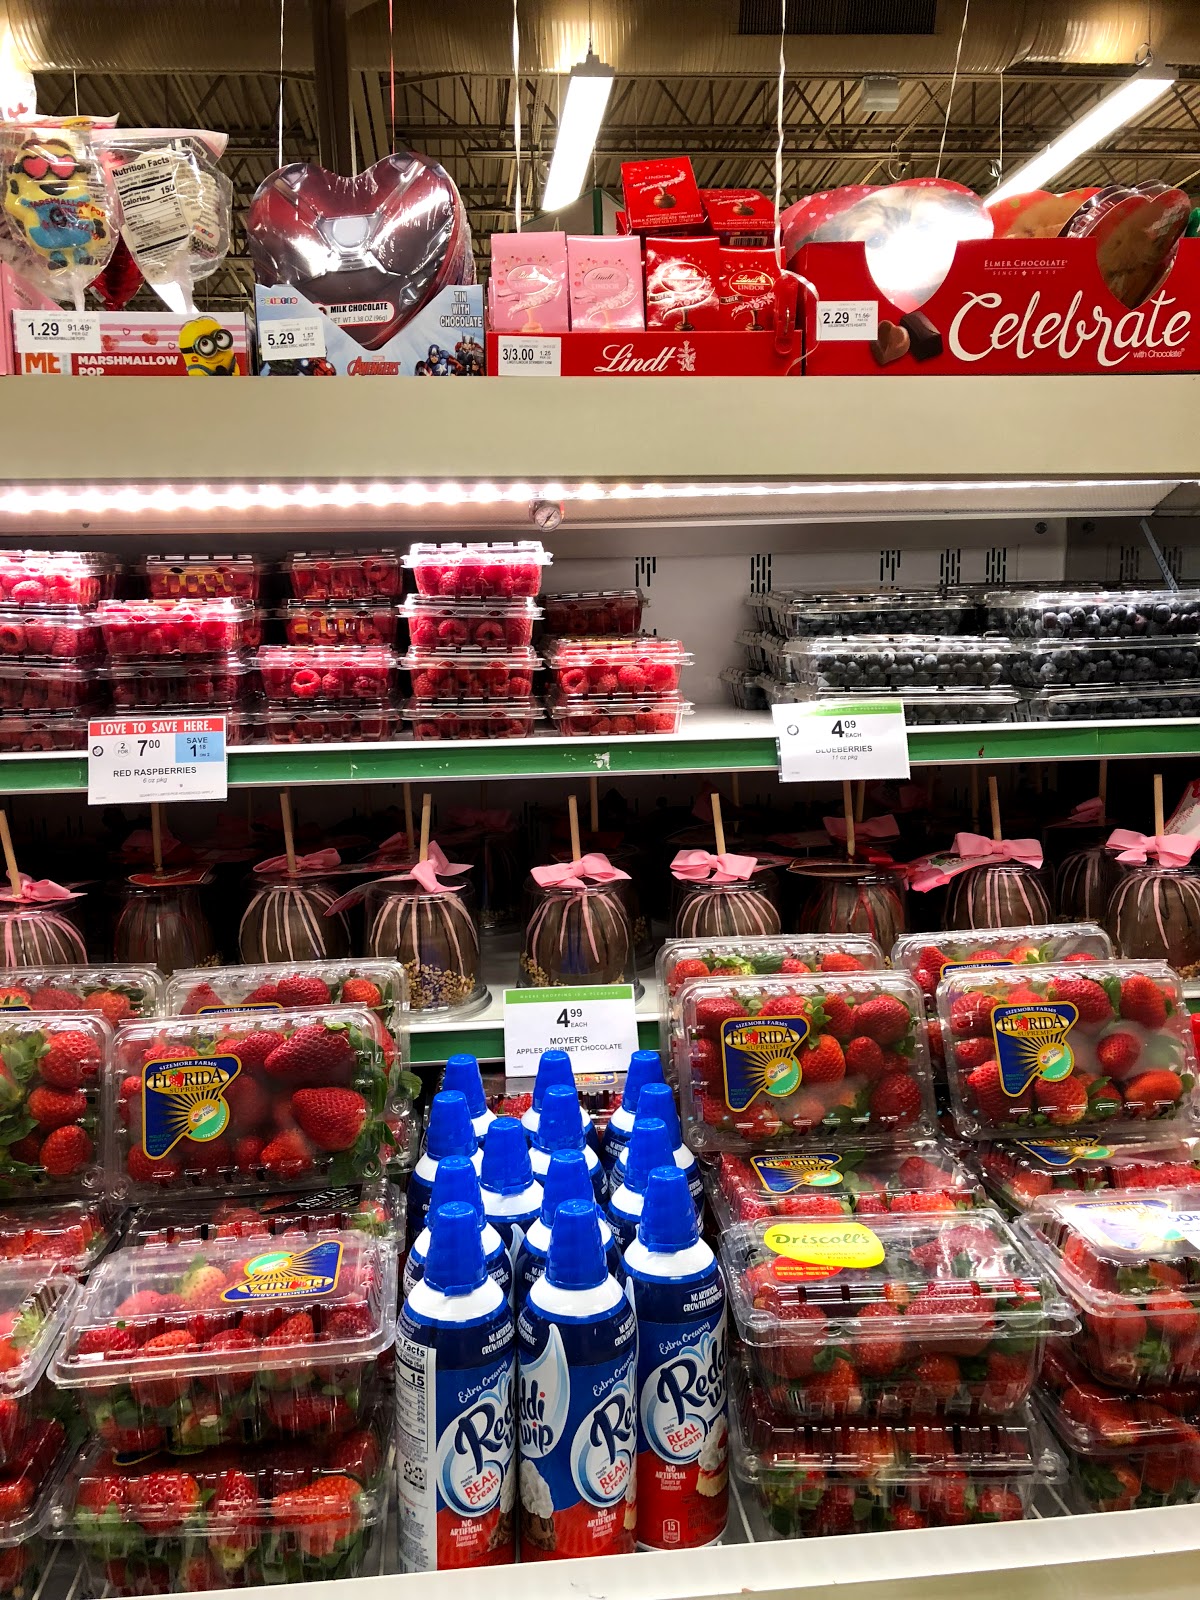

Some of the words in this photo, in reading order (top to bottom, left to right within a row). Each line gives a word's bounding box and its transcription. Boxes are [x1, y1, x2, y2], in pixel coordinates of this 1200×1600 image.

[112, 163, 146, 177] Nutrition
[148, 156, 170, 168] Facts
[122, 194, 151, 207] Calories
[984, 259, 1012, 268] ELMER
[1013, 259, 1066, 267] CHOCOLATE
[454, 291, 468, 302] TIN
[330, 305, 348, 314] MILK
[348, 302, 388, 312] CHOCOLATE
[451, 303, 470, 316] WITH
[440, 316, 483, 328] CHOCOLATE
[823, 312, 850, 324] 2.29
[28, 322, 59, 336] 1.29
[949, 290, 1192, 367] Celebrate
[267, 332, 295, 346] 5.29
[78, 355, 178, 366] MARSHMALLOW
[502, 348, 534, 360] 3/3.00
[594, 344, 677, 372] Lindt
[78, 367, 104, 376] POP
[101, 723, 126, 735] LOVE
[133, 723, 146, 733] TO
[152, 722, 178, 732] SAVE
[184, 720, 213, 731] HERE.
[134, 767, 197, 776] RASPBERRIES
[1005, 1007, 1034, 1015] SIZEMORE
[736, 1020, 765, 1028] SIZEMORE
[999, 1014, 1065, 1031] FLORIDA
[550, 1036, 588, 1045] MOYER'S
[728, 1028, 795, 1045] FLORIDA
[159, 1060, 193, 1071] SIZEMORE
[151, 1068, 224, 1089] FLORIDA
[772, 1234, 870, 1244] Driscoll's
[246, 1278, 327, 1293] FLORIDA
[691, 1293, 698, 1302] NO
[698, 1284, 718, 1298] ARTIFICIAL
[683, 1300, 706, 1312] GROWTH
[619, 1324, 625, 1334] NO
[489, 1333, 495, 1343] NO
[659, 1341, 682, 1355] Extra
[682, 1321, 711, 1343] Creamy
[404, 1341, 425, 1357] Facts
[482, 1338, 503, 1355] GROWTH
[410, 1373, 425, 1386] 15
[592, 1377, 614, 1397] Extra
[614, 1350, 634, 1378] Creamy
[457, 1384, 482, 1404] Extra
[482, 1361, 508, 1387] Creamy
[663, 1423, 675, 1431] made
[667, 1423, 699, 1446] REAL
[672, 1432, 702, 1452] Cream
[595, 1466, 607, 1476] made
[599, 1460, 626, 1489] REAL
[460, 1475, 473, 1484] made
[464, 1470, 496, 1498] REAL
[604, 1467, 629, 1495] Cream
[469, 1478, 499, 1506] Cream
[597, 1509, 608, 1517] NO
[462, 1519, 472, 1527] NO
[586, 1513, 617, 1528] ARTIFICIAL
[667, 1521, 675, 1531] 15
[450, 1524, 483, 1536] ARTIFICIAL
